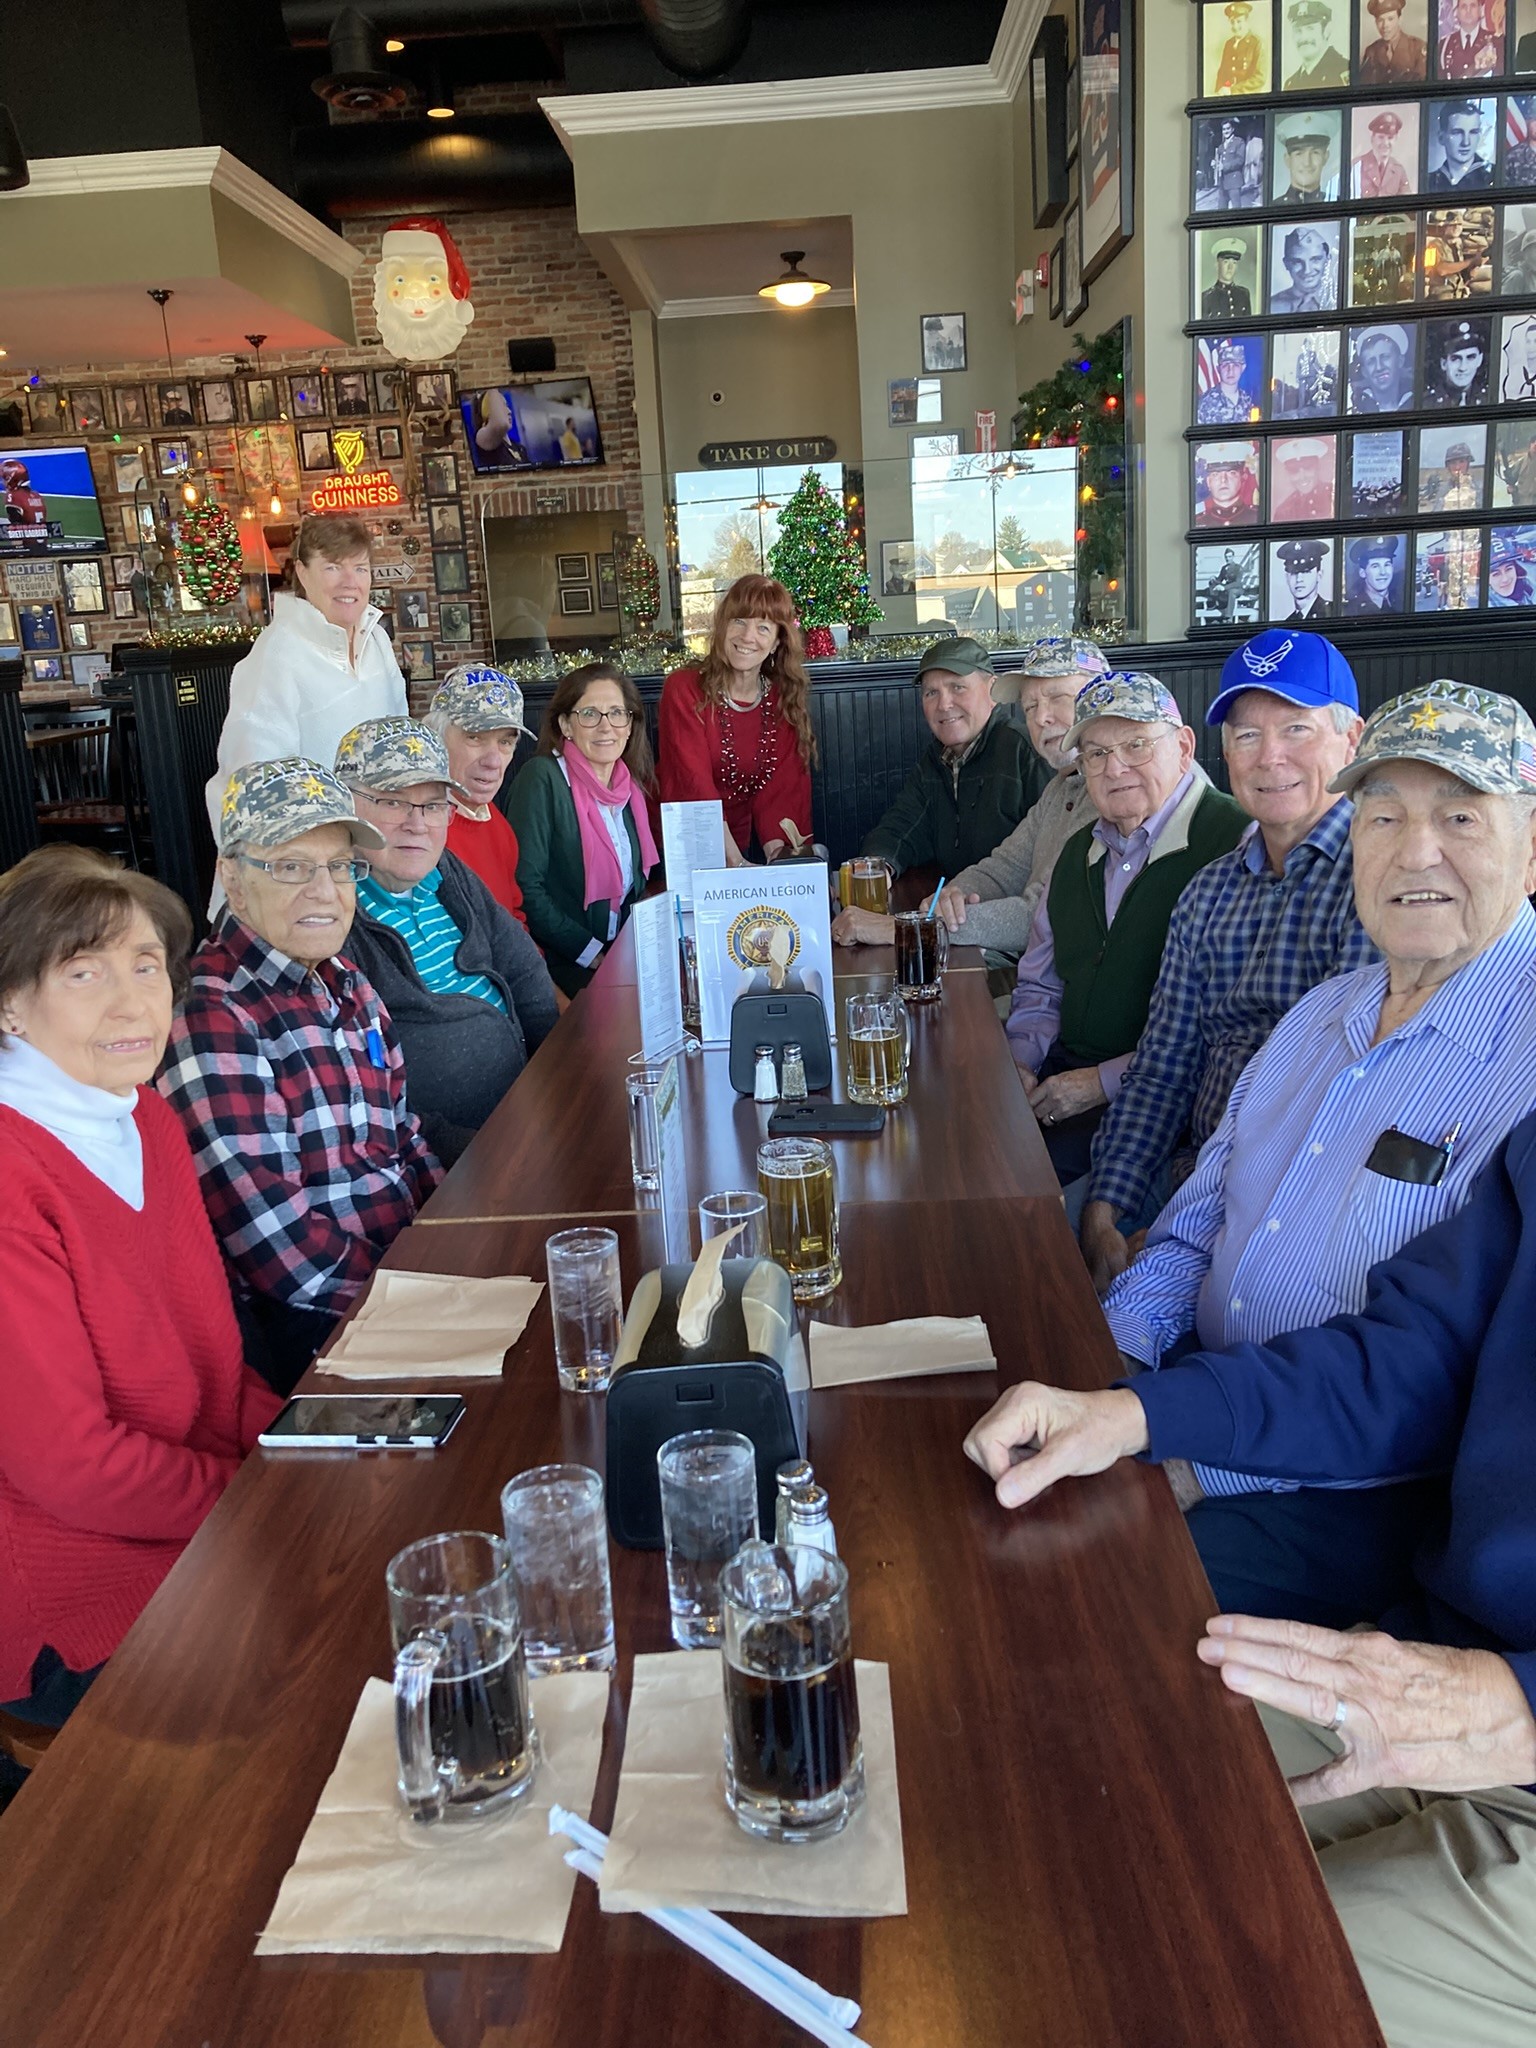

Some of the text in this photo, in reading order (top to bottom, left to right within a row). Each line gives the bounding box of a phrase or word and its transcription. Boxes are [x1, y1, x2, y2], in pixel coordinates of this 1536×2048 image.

[979, 415, 993, 425] FIRE
[709, 441, 825, 463] TAKE OUT
[325, 471, 389, 489] DRAUGHT
[311, 485, 399, 509] GUINNESS
[7, 563, 54, 575] NOTICE
[371, 567, 403, 577] AIN
[9, 574, 55, 583] HARD HATS
[16, 582, 52, 591] REQUIRED
[703, 884, 816, 901] AMERICAN LEGION
[736, 911, 786, 935] AMERICA
